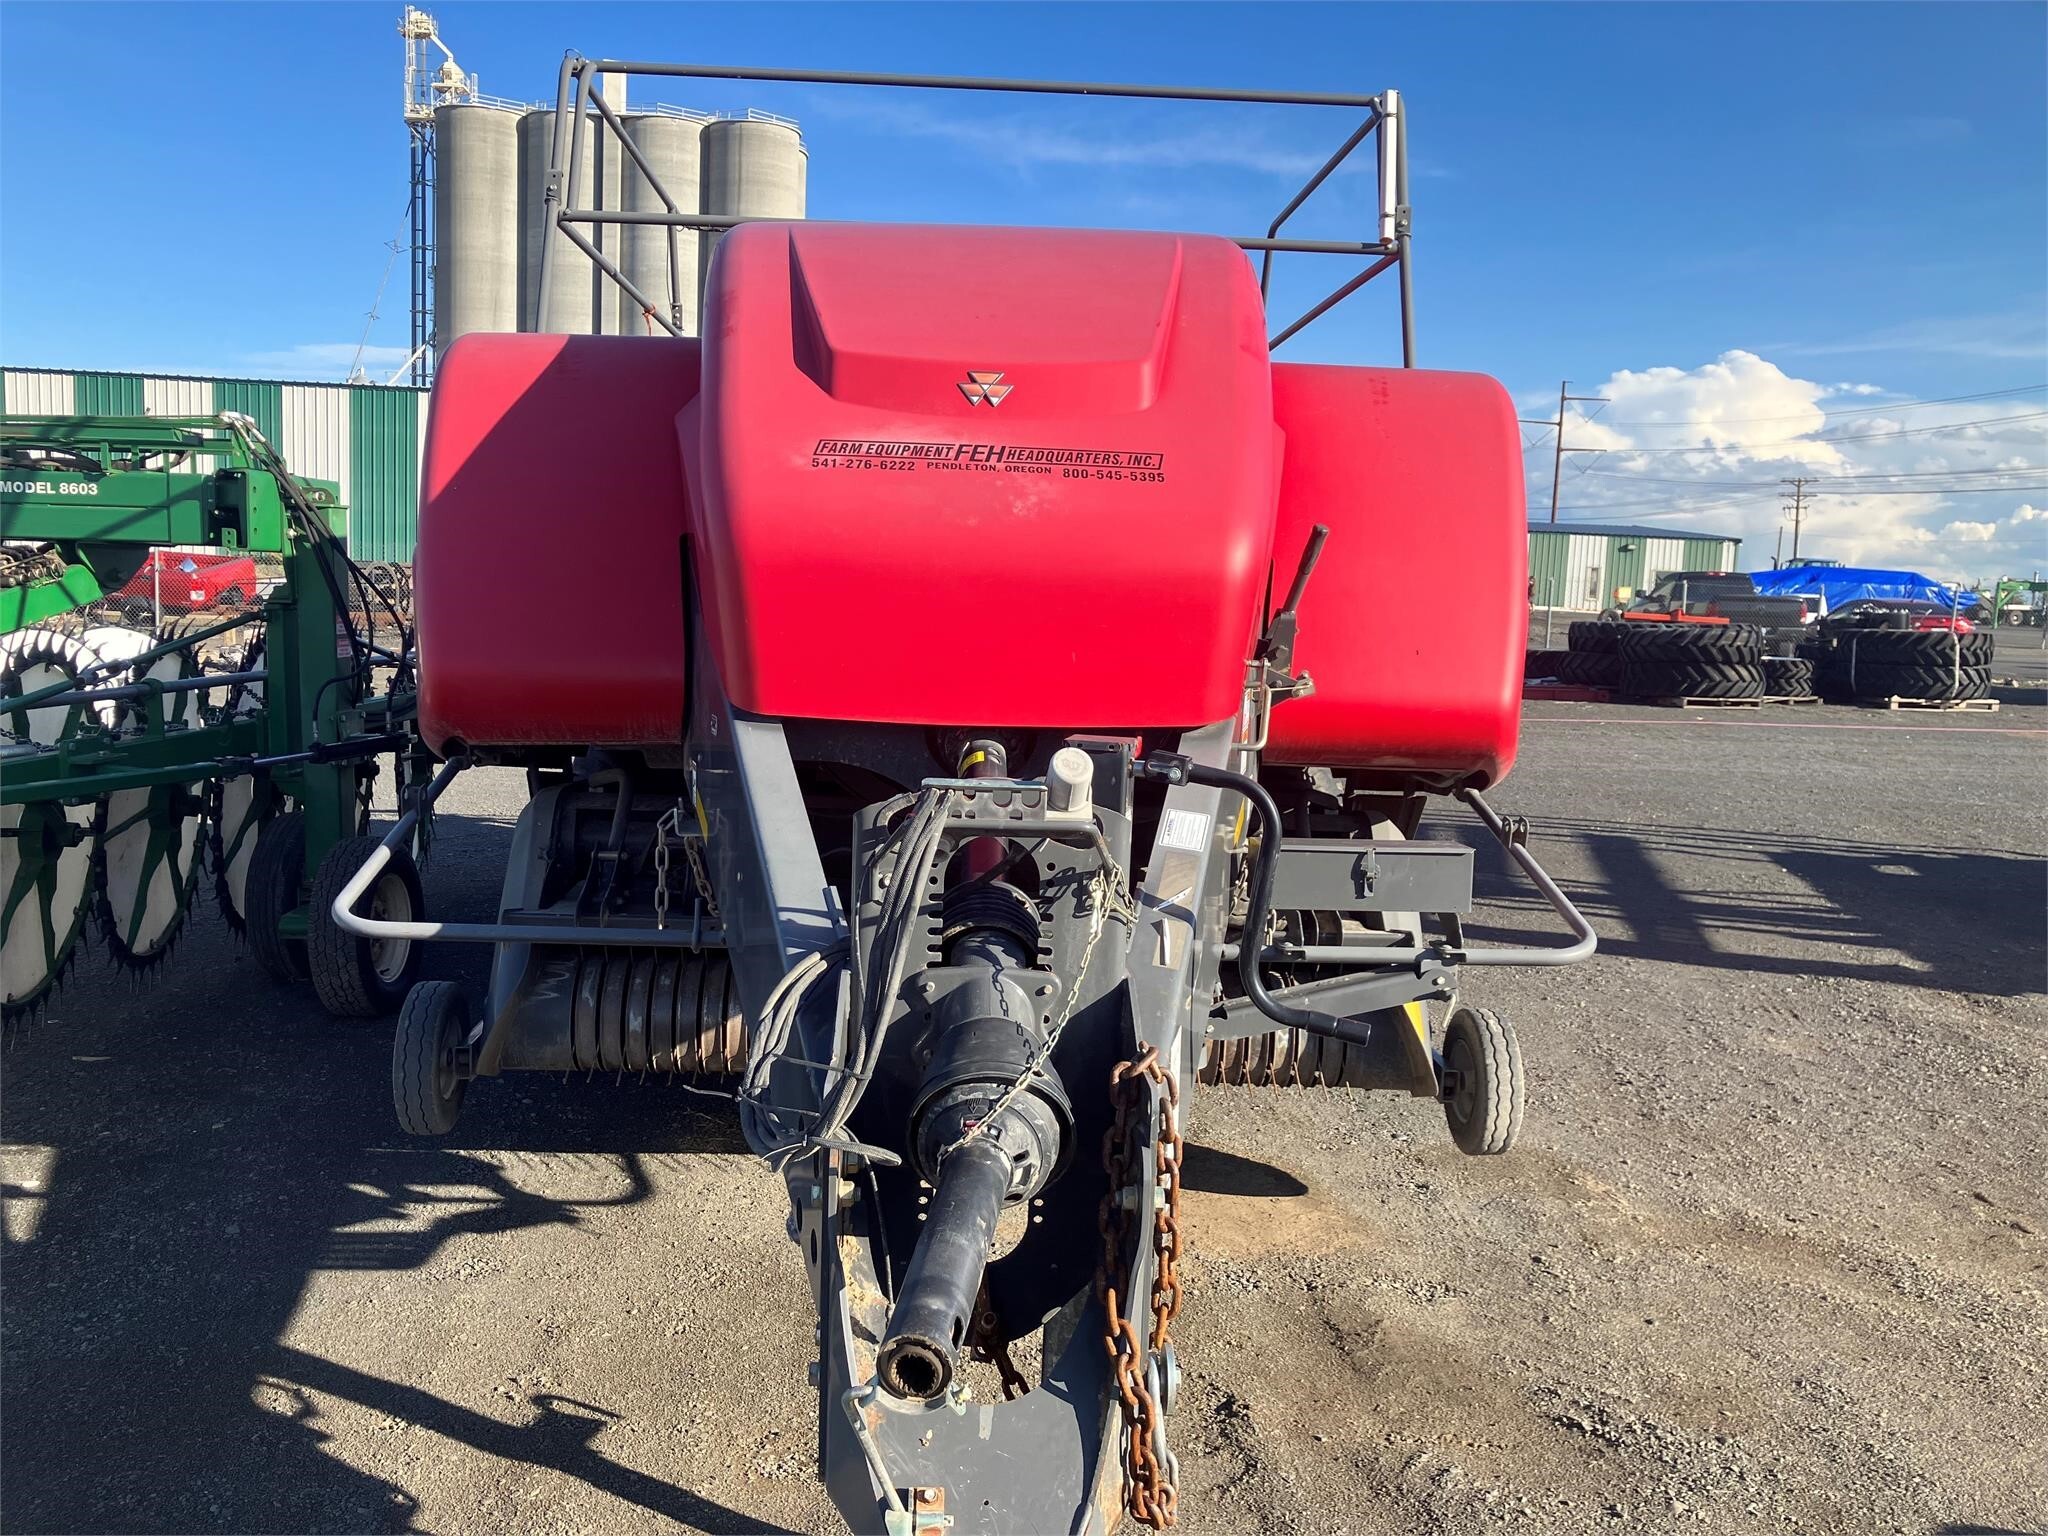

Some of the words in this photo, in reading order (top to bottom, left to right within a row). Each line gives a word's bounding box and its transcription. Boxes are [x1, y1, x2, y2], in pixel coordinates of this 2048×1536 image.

[820, 442, 863, 455] FARM
[865, 443, 954, 458] EQUIPMENT
[953, 444, 1007, 463] FEH
[1006, 448, 1125, 467] HEADQUARTERS,
[1127, 454, 1156, 467] INC.
[811, 457, 916, 471] 541-276-6222
[1004, 464, 1052, 475] OREGON
[1062, 468, 1165, 483] 800-545-5395
[0, 480, 57, 494] MODEL
[59, 482, 99, 496] 8603
